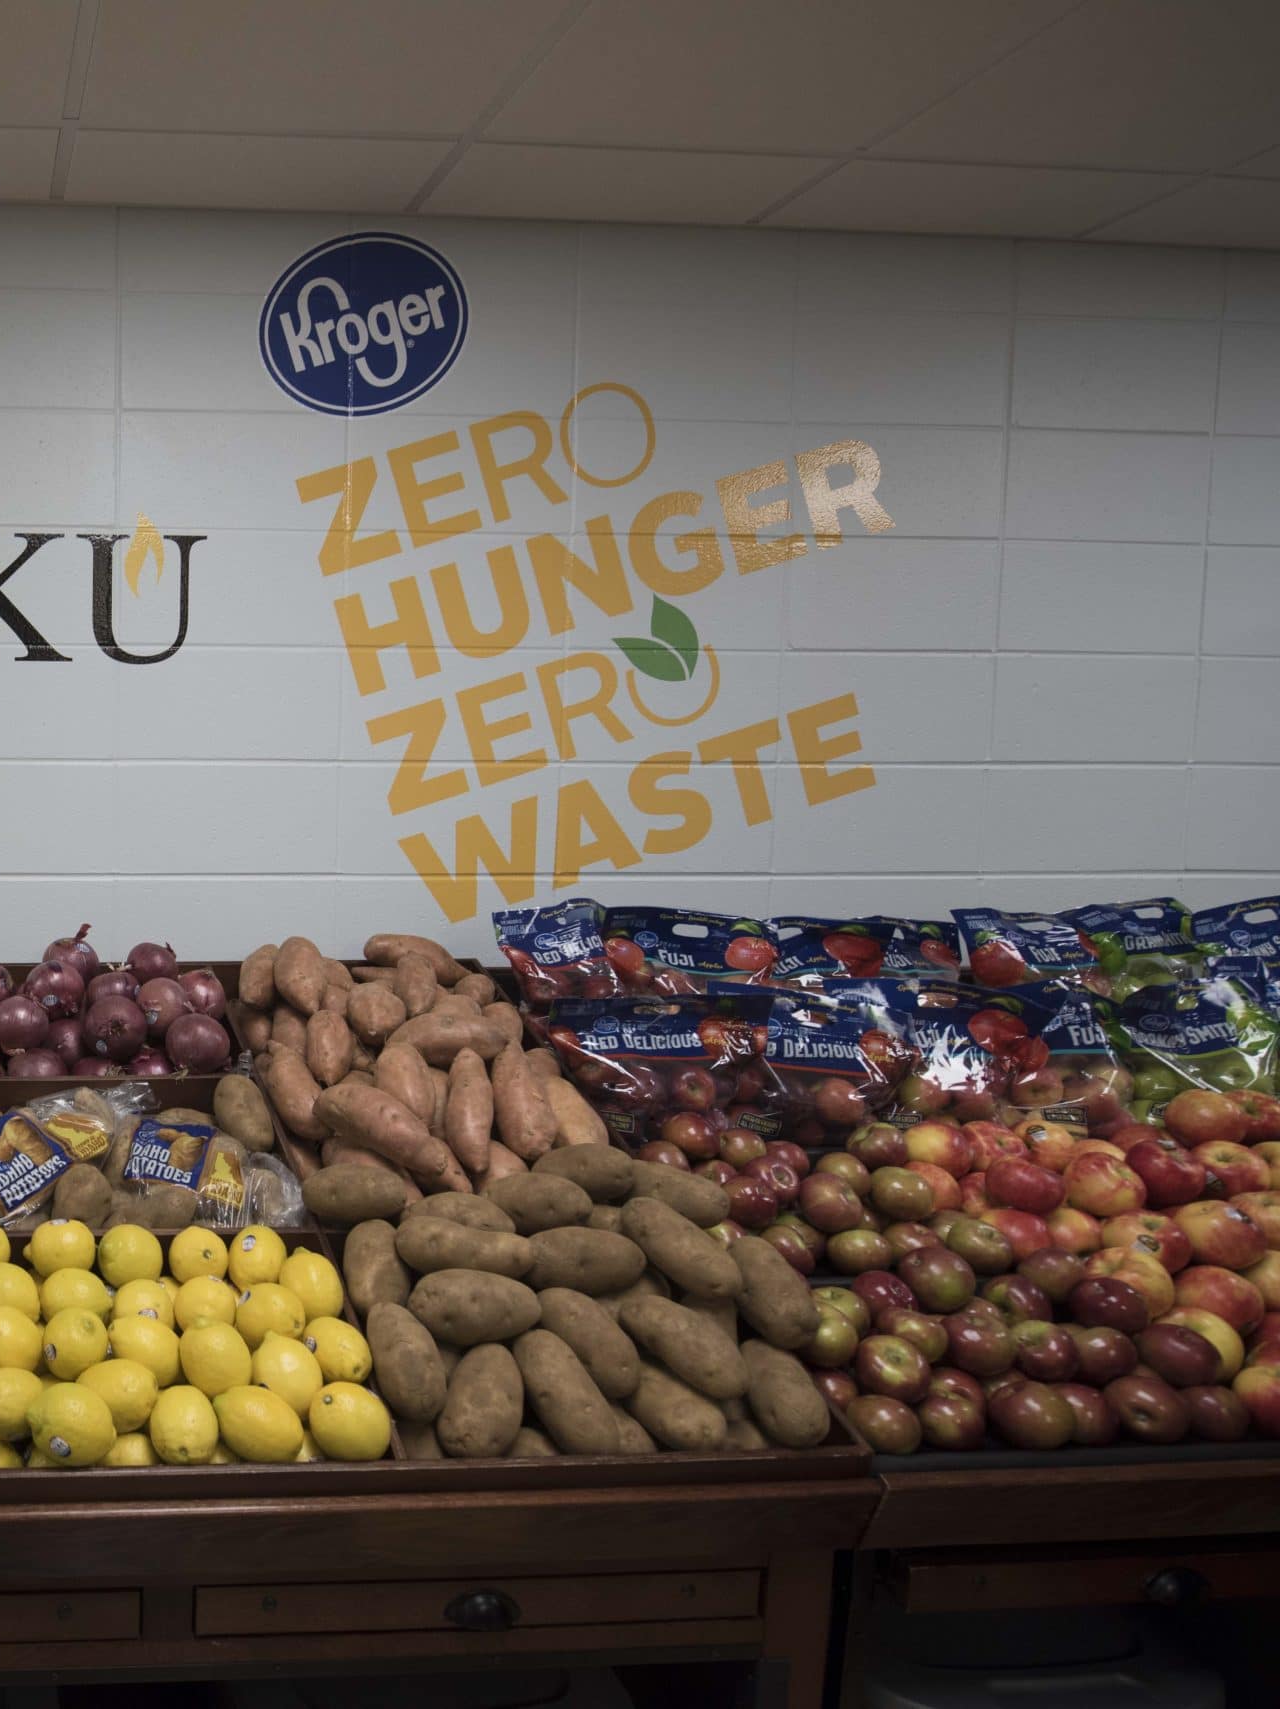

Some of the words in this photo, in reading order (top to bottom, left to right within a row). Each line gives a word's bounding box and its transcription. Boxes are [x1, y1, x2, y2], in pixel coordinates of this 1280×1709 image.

[279, 277, 447, 388] Kroger
[295, 382, 656, 577] ZERO
[332, 438, 897, 697] HUNGER
[365, 643, 720, 817] ZERO
[397, 692, 878, 925] WASTE
[531, 949, 562, 965] RED
[657, 948, 695, 967] FUJI
[1027, 945, 1062, 963] FUJI
[585, 1034, 619, 1050] RED
[623, 1032, 703, 1050] DELICIOUS
[1067, 1024, 1106, 1047] FUJ
[783, 1038, 863, 1059] DELICIOUS
[124, 1156, 193, 1184] POTATOES
